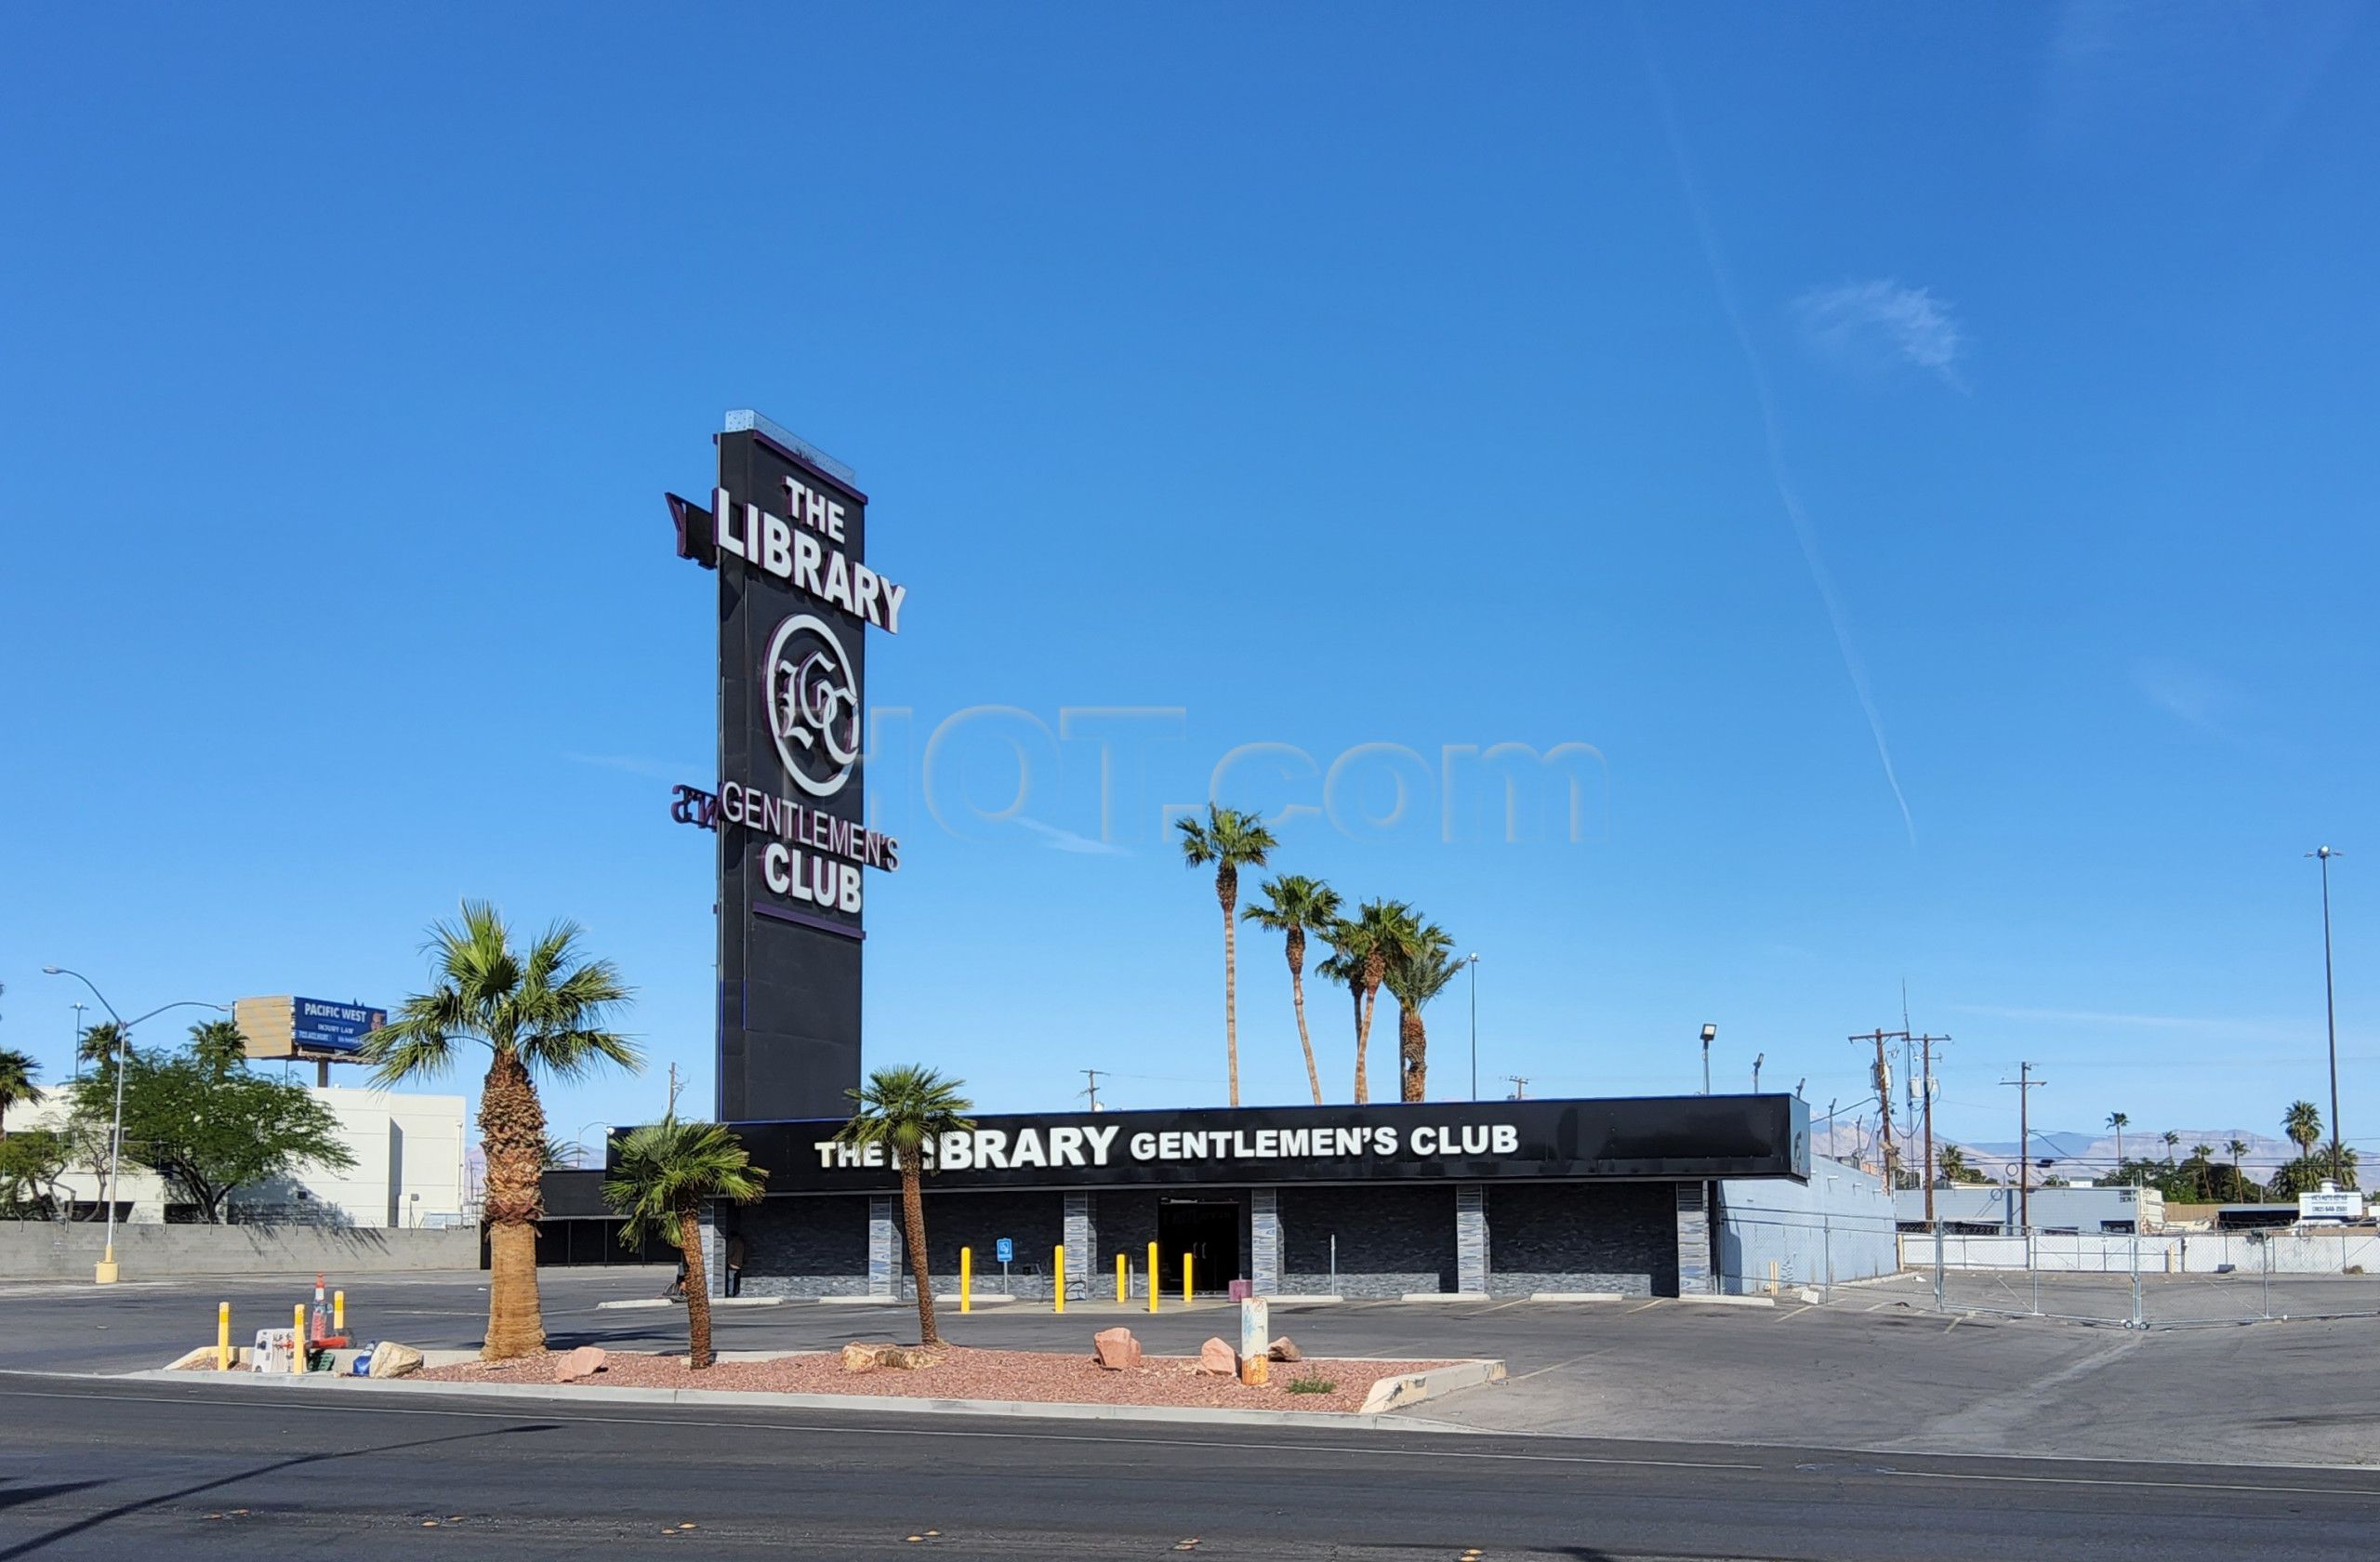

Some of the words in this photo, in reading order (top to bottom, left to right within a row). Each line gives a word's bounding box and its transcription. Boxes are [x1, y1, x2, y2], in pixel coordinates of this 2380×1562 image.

[783, 475, 844, 543] THE
[714, 486, 907, 634] LIBRARY
[721, 781, 900, 872] GENTLEMEN'S
[763, 842, 862, 914] CLUB
[304, 1002, 340, 1018] PACIFIC
[341, 1009, 367, 1023] WEST
[814, 1141, 883, 1168] THE
[1130, 1126, 1397, 1160] GENTLEMEN'S
[1409, 1125, 1519, 1156] CLUB
